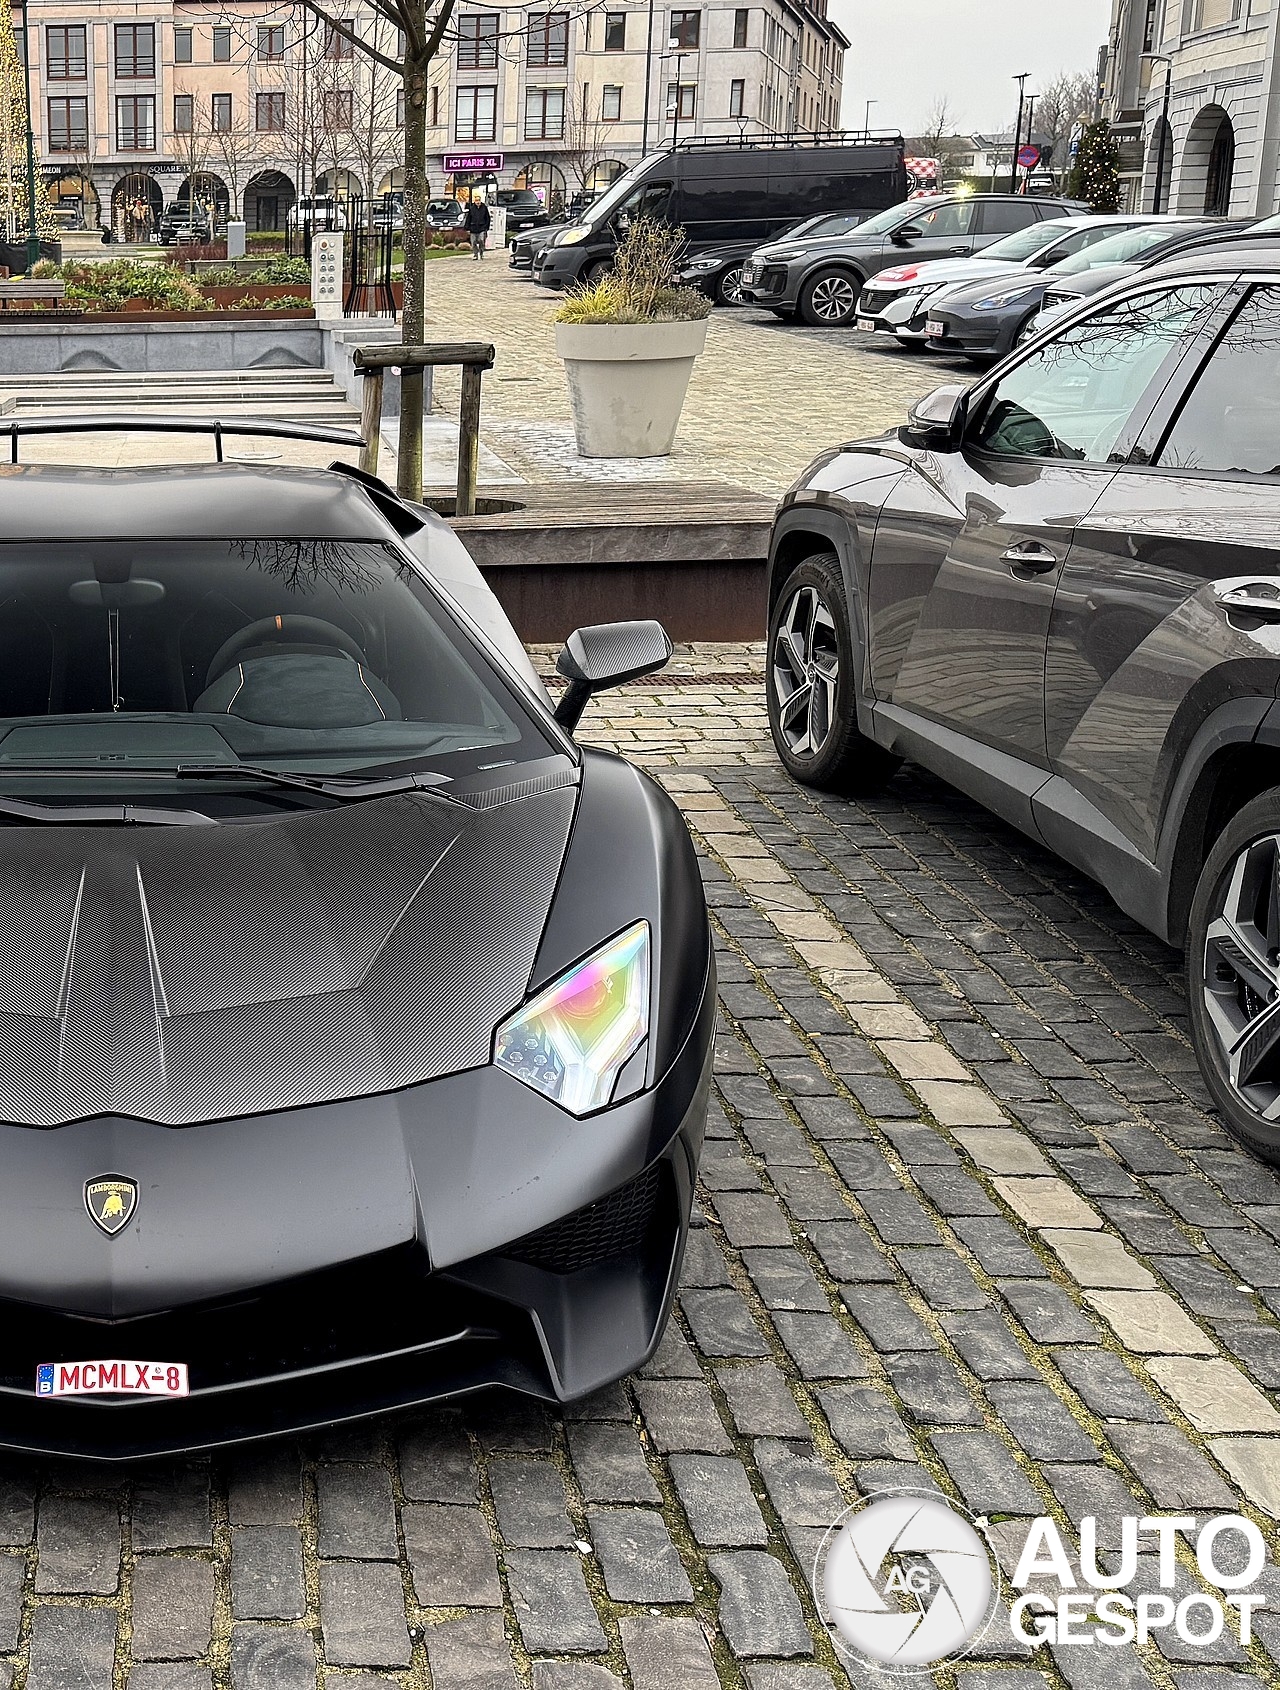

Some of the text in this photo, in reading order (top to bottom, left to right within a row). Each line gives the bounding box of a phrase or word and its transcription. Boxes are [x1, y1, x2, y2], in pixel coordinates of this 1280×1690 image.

[462, 159, 484, 167] PARIS
[486, 158, 497, 166] XL
[149, 165, 181, 174] SQUARE
[90, 1182, 132, 1194] LAMBORGHINI
[40, 1363, 180, 1393] B MCMLX-8
